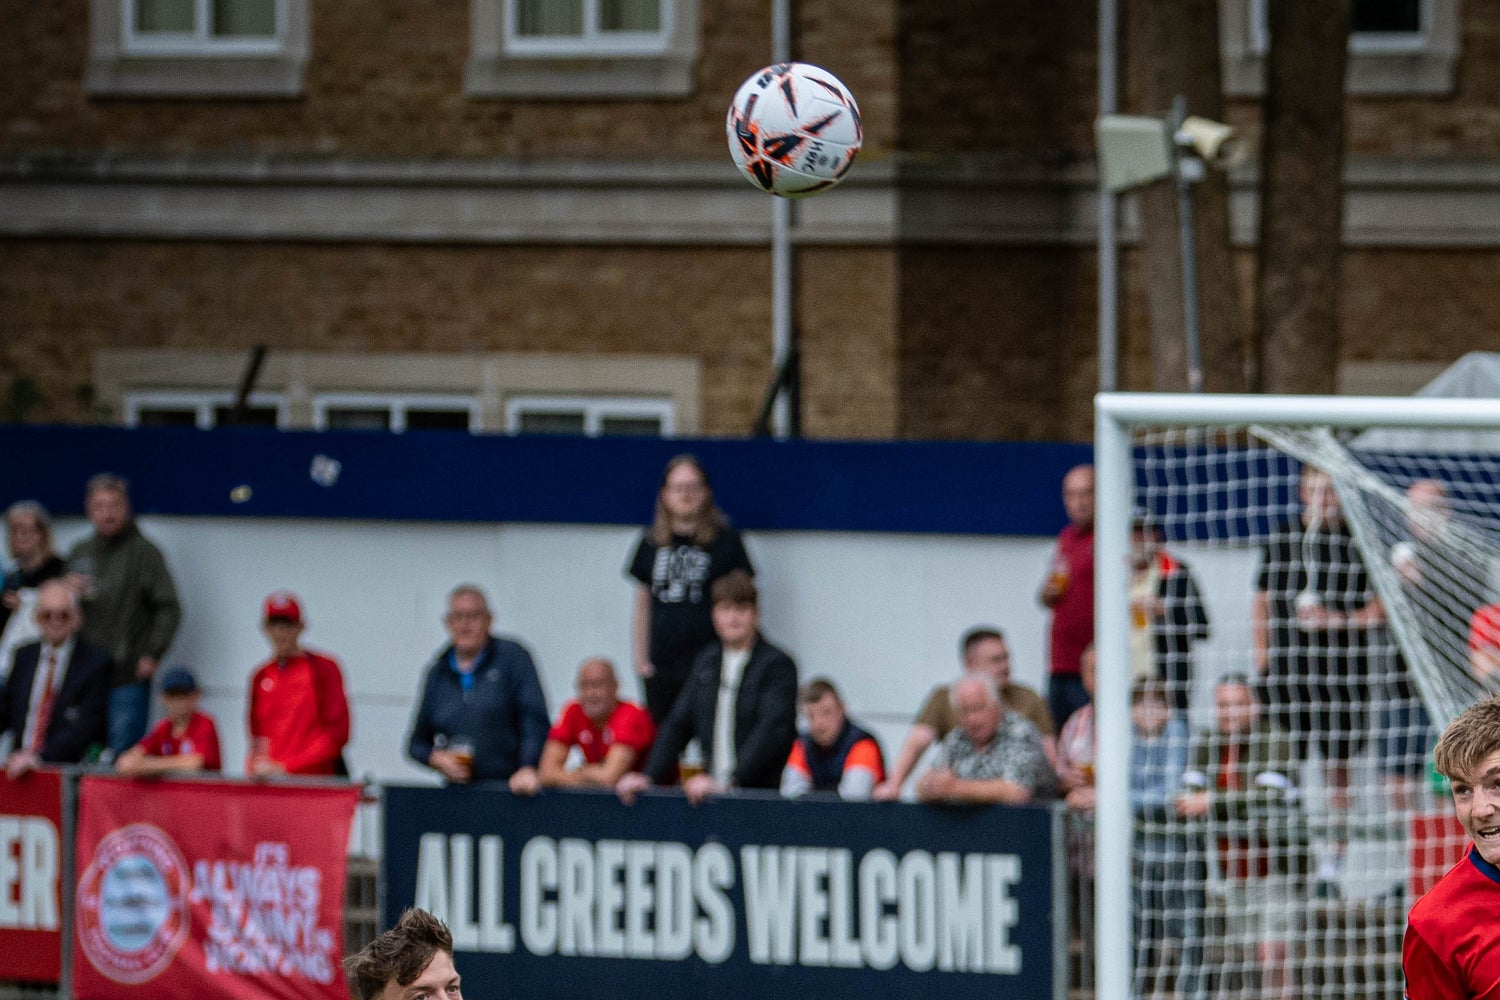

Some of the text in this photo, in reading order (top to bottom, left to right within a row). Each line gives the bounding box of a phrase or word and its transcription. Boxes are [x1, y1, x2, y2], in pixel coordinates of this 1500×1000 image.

[413, 833, 1022, 975] ALL CREEDS WELCOME
